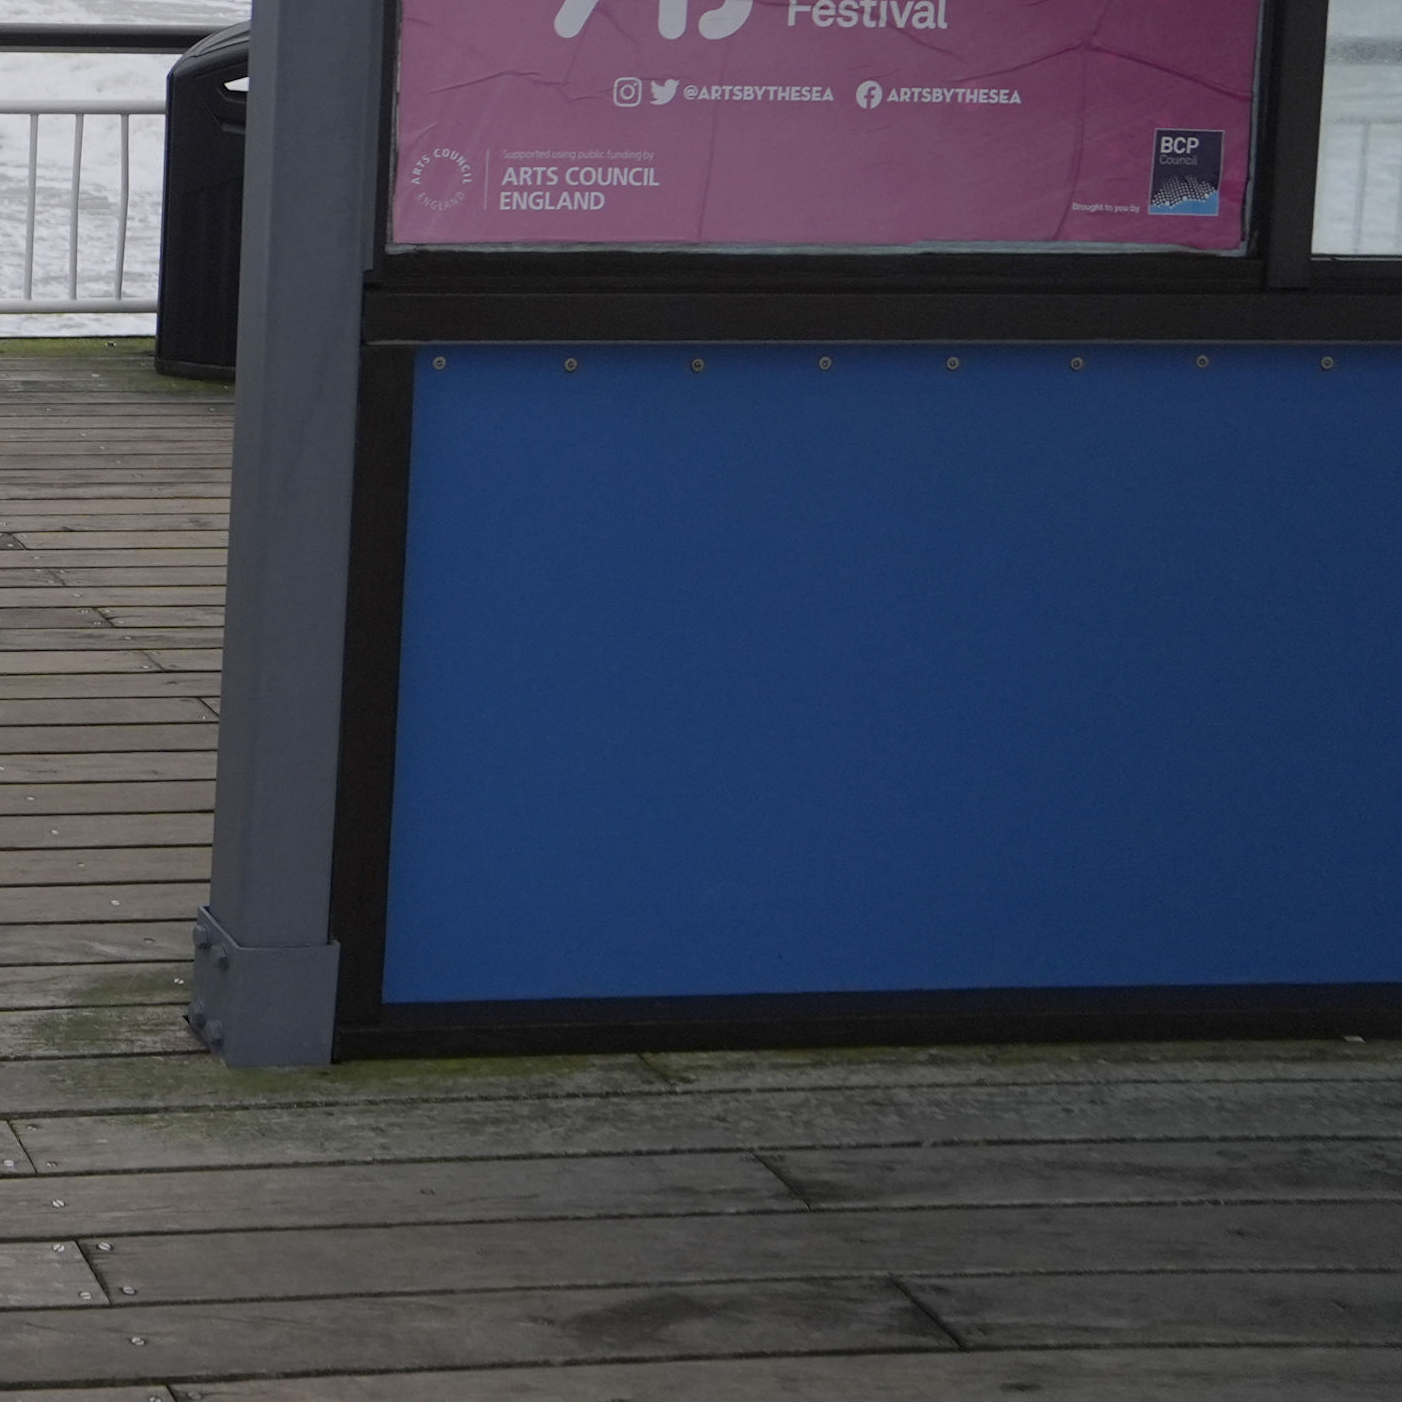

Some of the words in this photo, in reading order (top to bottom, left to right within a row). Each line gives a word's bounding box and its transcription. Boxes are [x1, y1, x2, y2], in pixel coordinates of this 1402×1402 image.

[683, 84, 835, 103] @ARTSBYTHESEA
[886, 87, 1022, 105] ARTSBYTHESEA
[1159, 136, 1200, 154] BCP
[1159, 154, 1198, 165] Council
[411, 154, 431, 185] ARTS
[501, 167, 559, 186] ARTS
[565, 167, 660, 187] COUNCIL
[499, 191, 606, 211] ENGLAND
